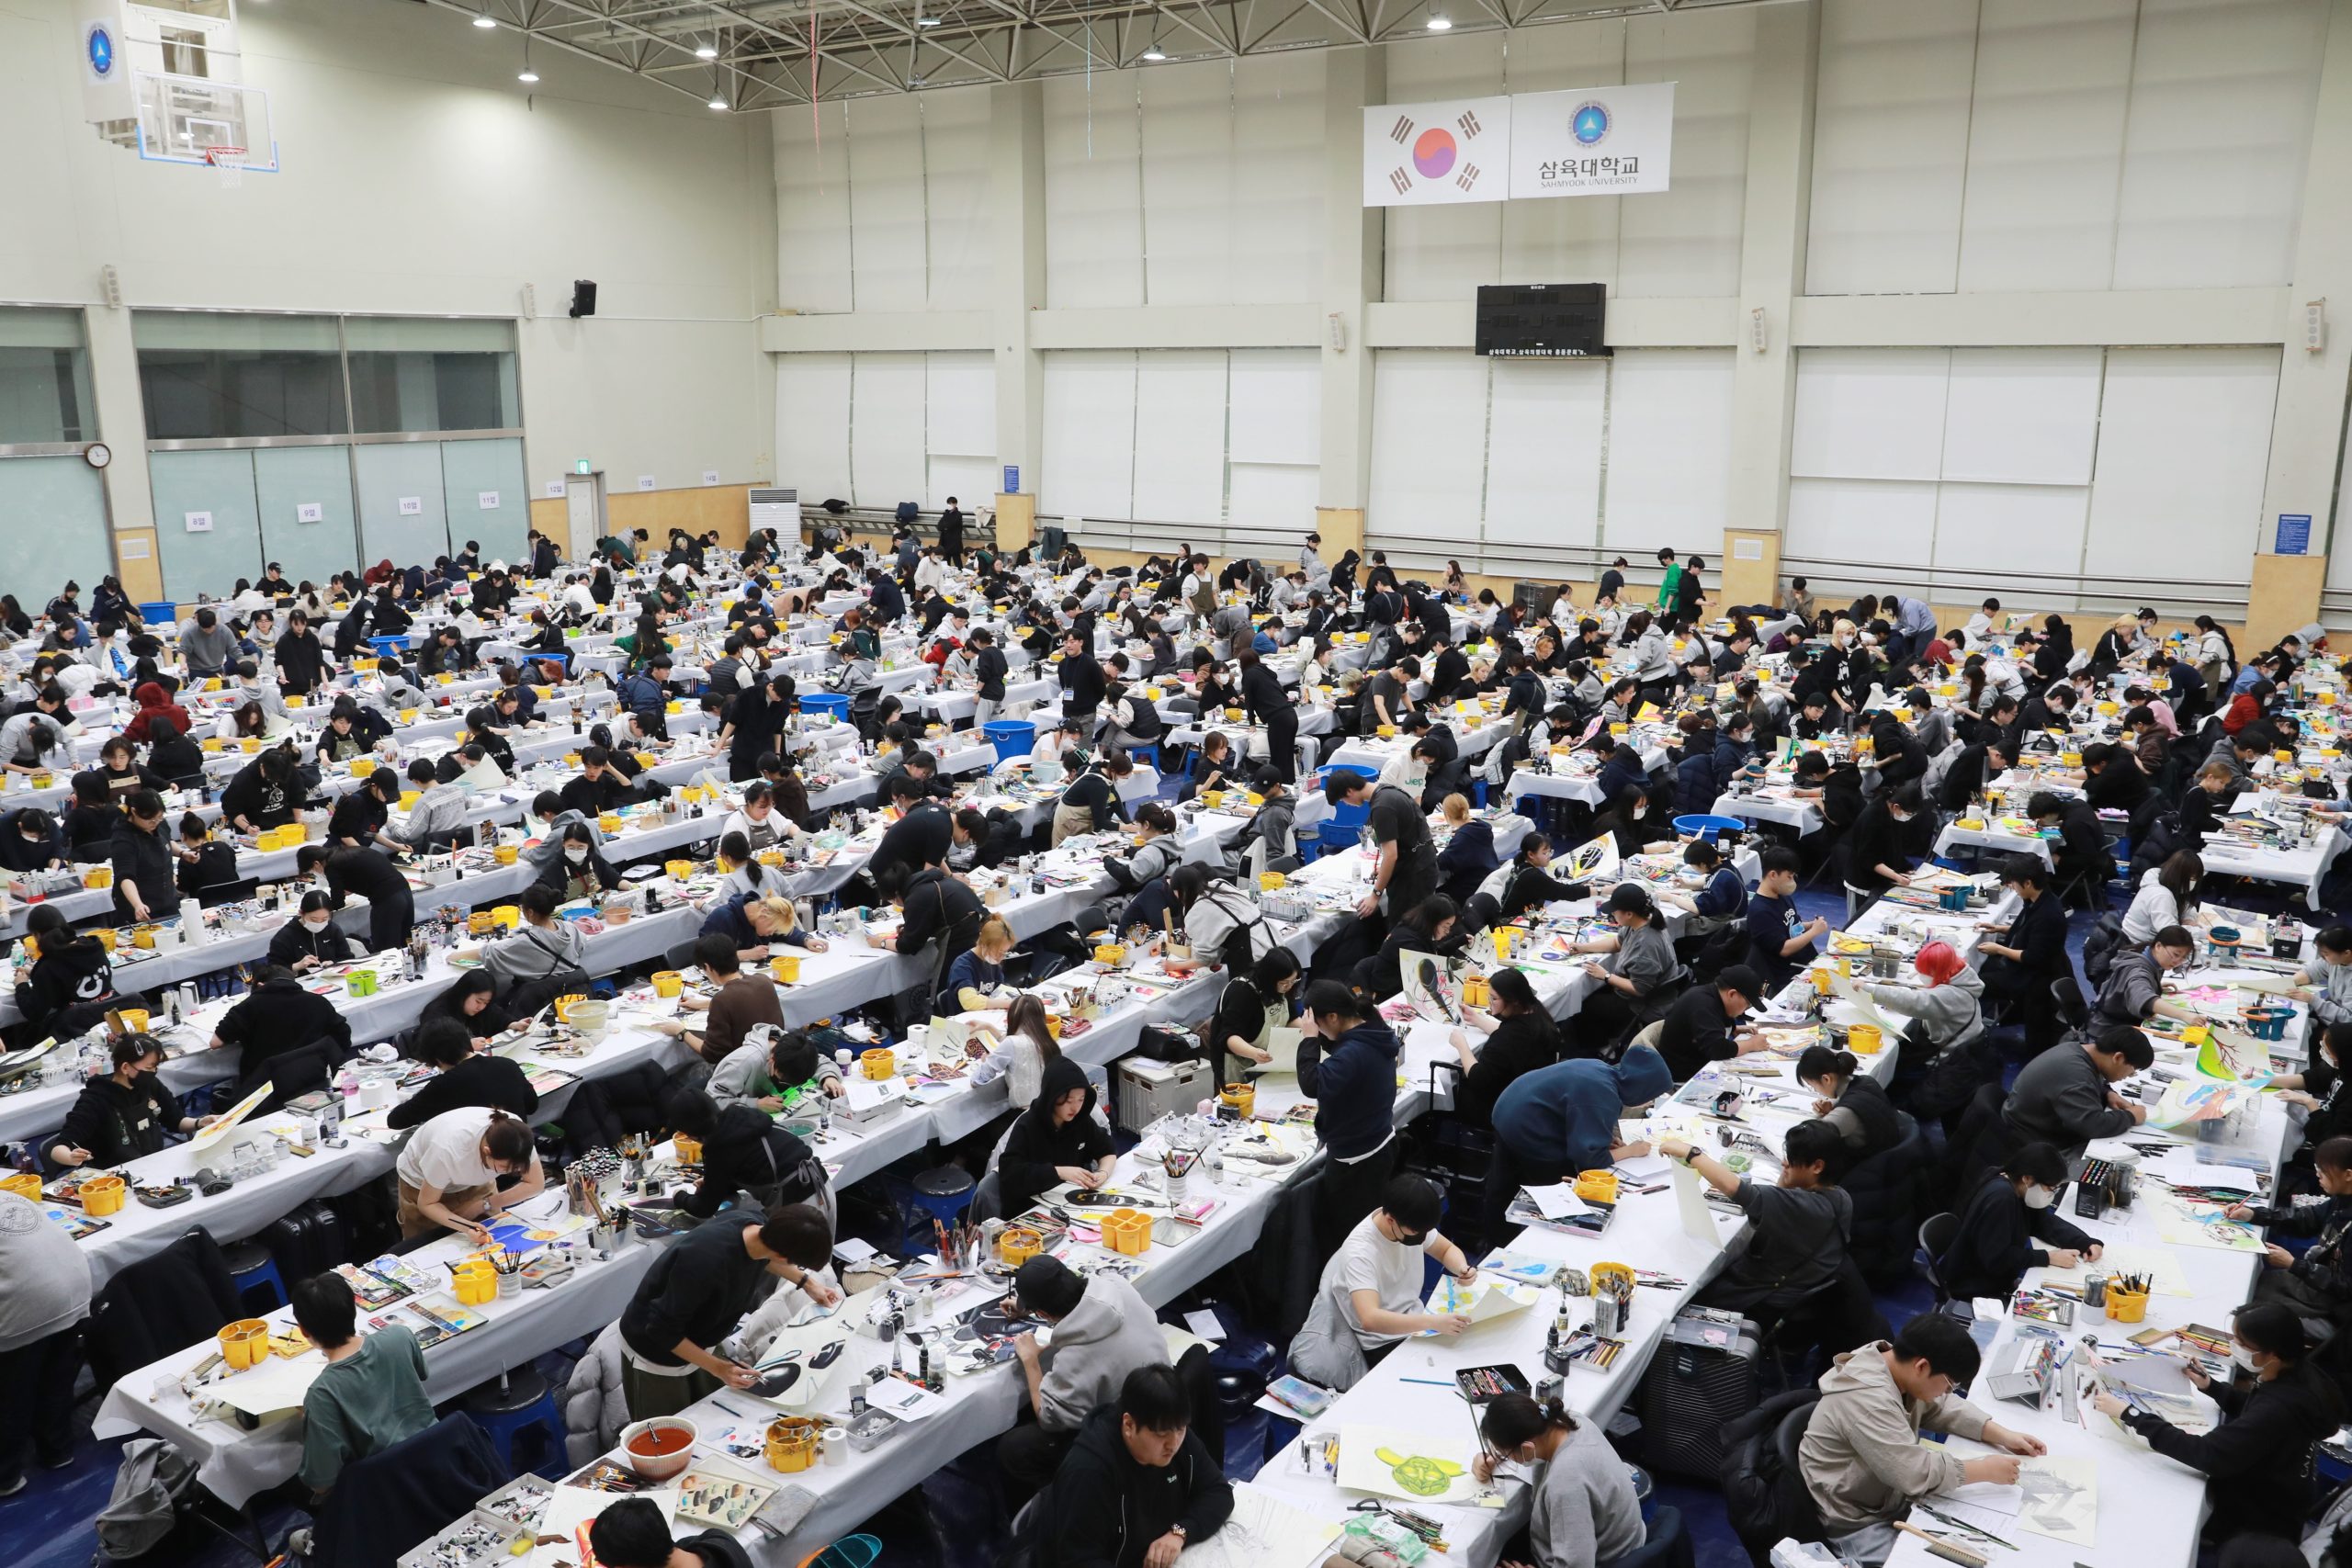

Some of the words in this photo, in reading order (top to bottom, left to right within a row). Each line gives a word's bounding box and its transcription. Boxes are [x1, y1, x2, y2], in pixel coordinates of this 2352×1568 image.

[1539, 156, 1639, 179] 삼육대학교
[1541, 179, 1587, 188] SAHMYOOK
[1589, 177, 1638, 186] UNIVERSITY
